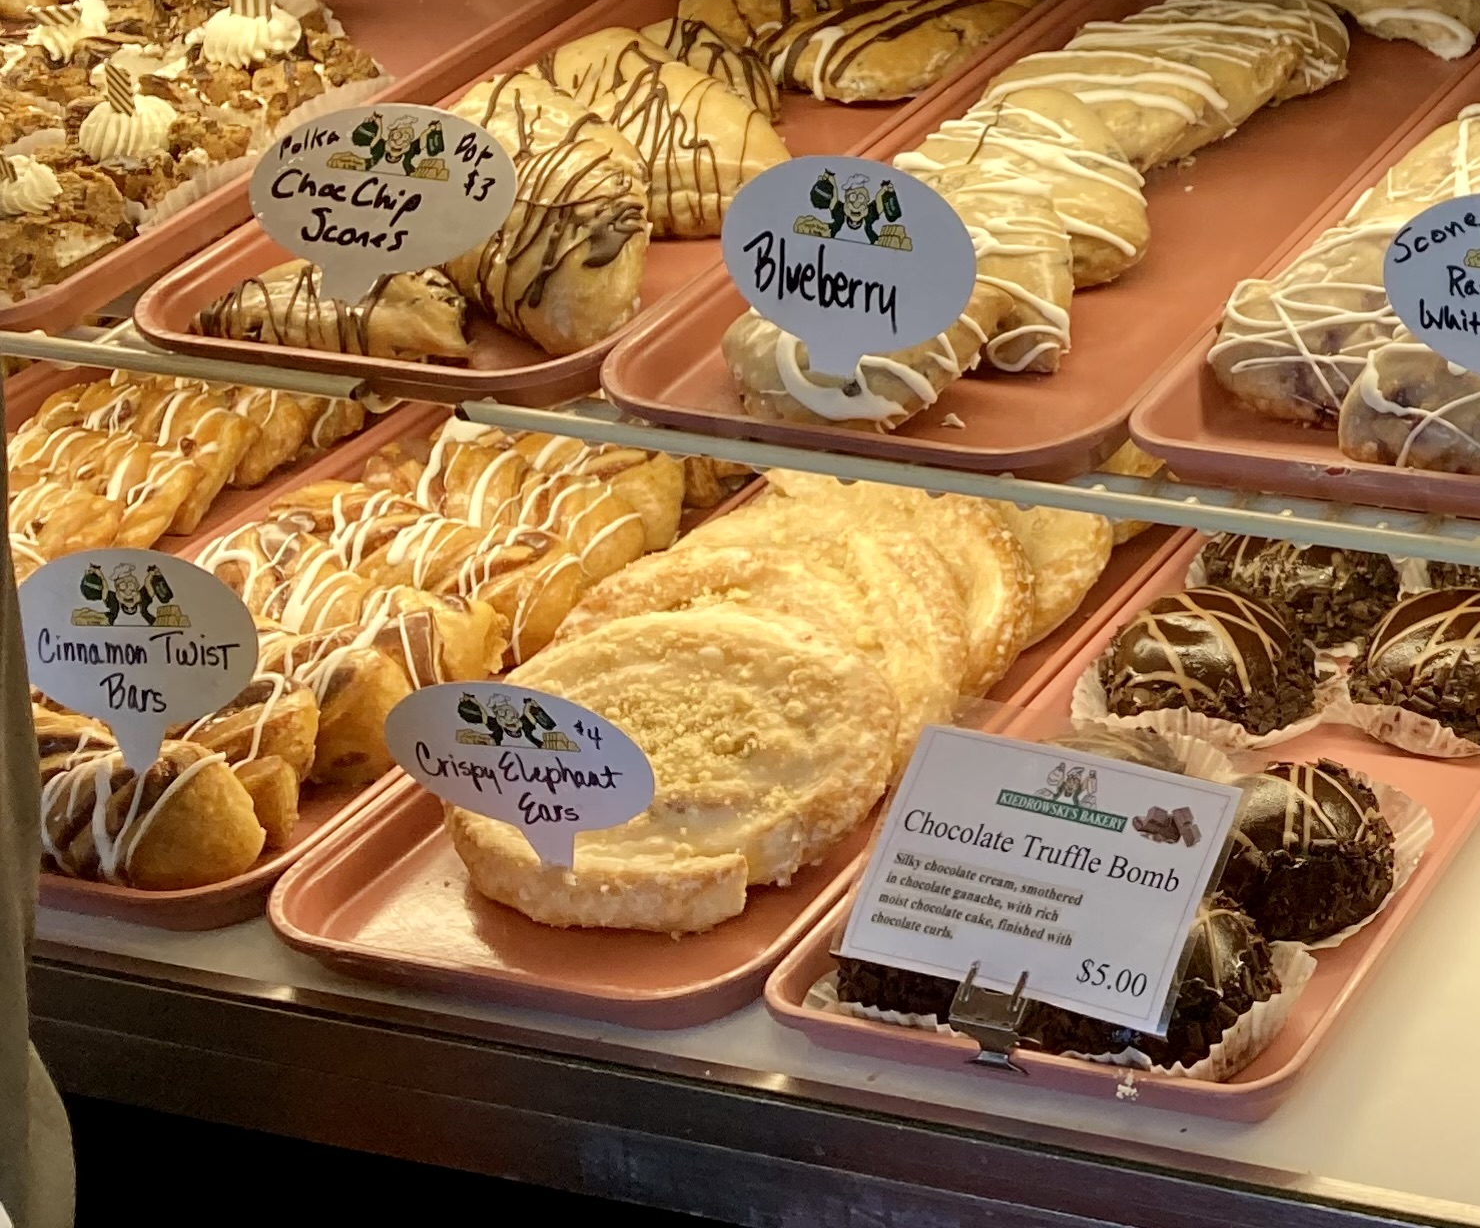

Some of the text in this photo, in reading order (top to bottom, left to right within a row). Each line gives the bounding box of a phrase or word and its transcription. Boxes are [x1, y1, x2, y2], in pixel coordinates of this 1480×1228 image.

[463, 169, 497, 202] $3
[300, 206, 410, 253] Scones
[742, 229, 898, 336] Blueberry
[37, 627, 149, 667] Cinnamon
[98, 671, 168, 714] Bars
[414, 740, 625, 795] Crispy Elephant
[517, 790, 581, 826] Ears
[998, 791, 1127, 832] KIEDROWSKI'S BAKERY
[903, 808, 1181, 894] Chocolate Truffle Bomb
[885, 871, 1060, 923] in chocolate ganache, with rich
[893, 852, 1085, 907] Silky chocolate cream, smothered
[870, 910, 921, 933] chocolate
[878, 891, 1074, 948] moist chocolate cake, finished with
[1075, 957, 1149, 1000] $5.00
